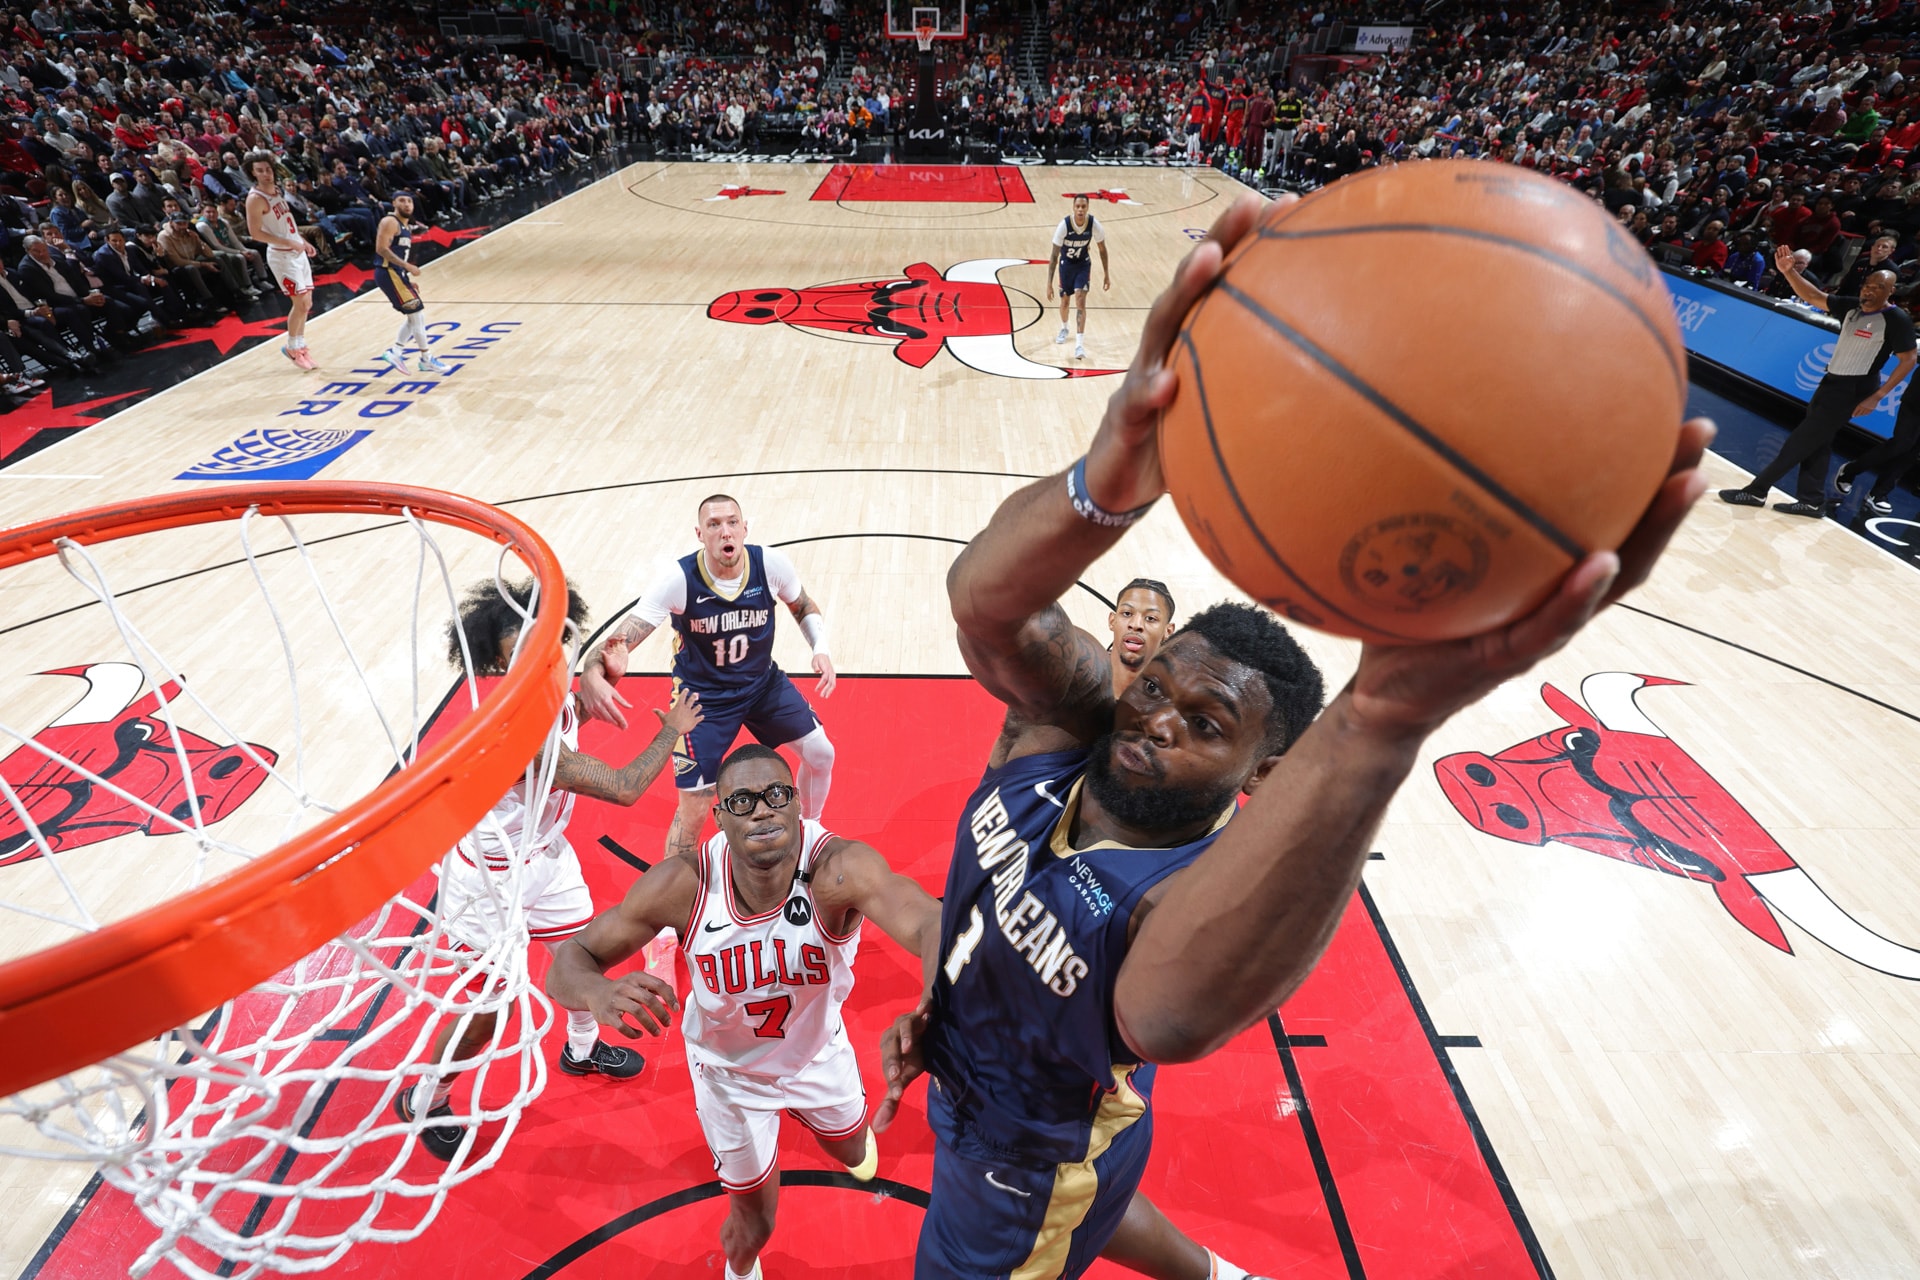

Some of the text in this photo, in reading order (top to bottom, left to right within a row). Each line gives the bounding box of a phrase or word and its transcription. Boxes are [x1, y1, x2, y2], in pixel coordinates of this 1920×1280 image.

[1369, 33, 1408, 45] Advocate
[909, 129, 945, 139] KIA
[286, 216, 296, 234] 3
[1066, 247, 1083, 259] 24
[690, 609, 769, 634] NEW ORLEANS
[712, 634, 749, 667] 10
[971, 786, 1017, 871] NEW
[1068, 875, 1101, 917] GARAGE
[1070, 856, 1113, 916] NEWAGE
[944, 904, 985, 985] 1
[695, 938, 830, 995] BULLS
[744, 995, 792, 1039] 7
